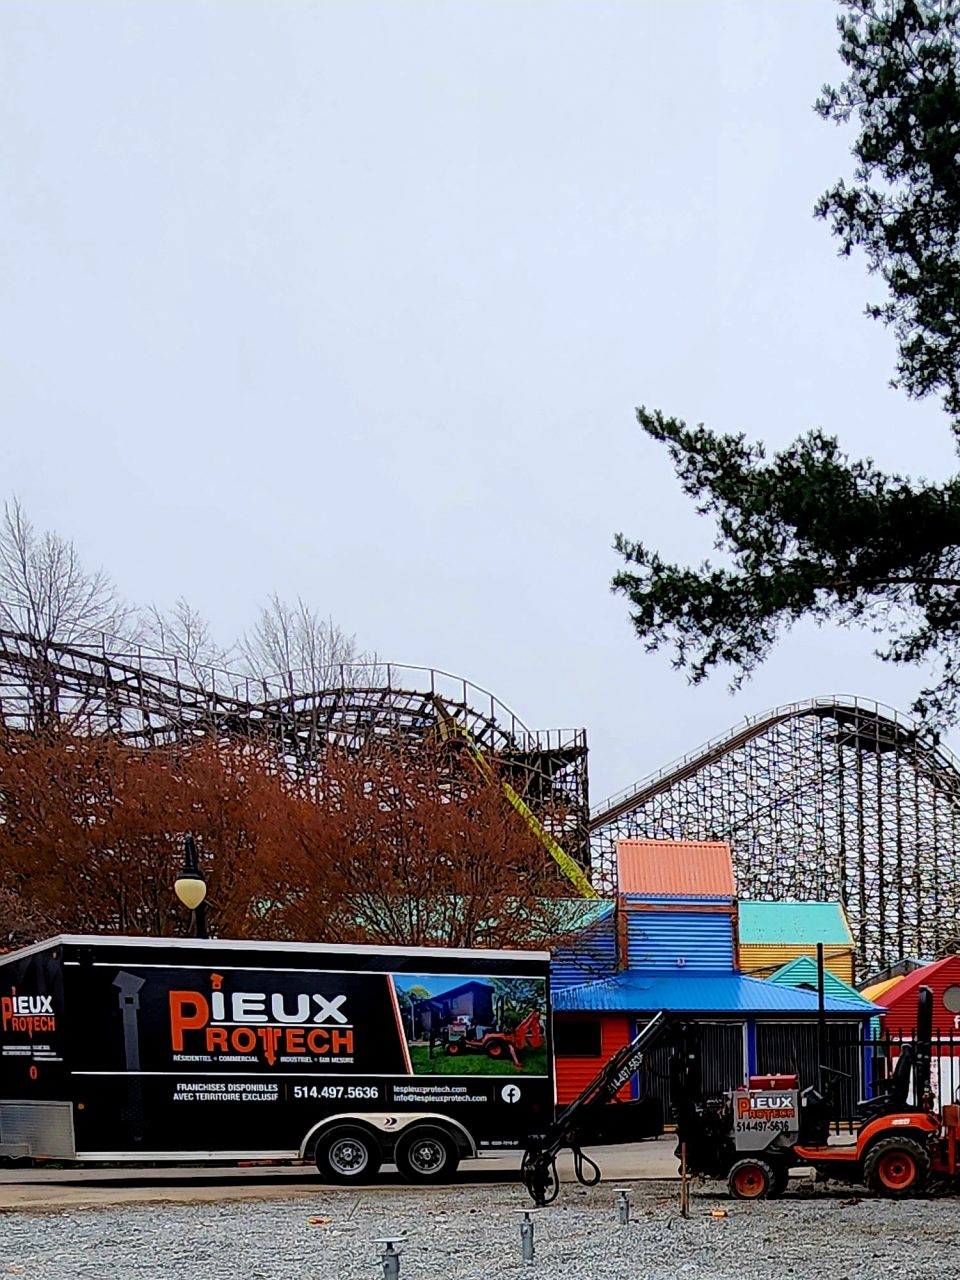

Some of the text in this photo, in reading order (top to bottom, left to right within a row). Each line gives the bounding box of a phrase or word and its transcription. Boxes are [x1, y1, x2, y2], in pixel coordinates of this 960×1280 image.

[177, 1083, 278, 1092] FRANCHISES DISPONIBLES
[294, 1086, 379, 1099] 514.497.5636
[242, 1093, 279, 1101] EXCLUSIF
[736, 1120, 789, 1132] 514-497-5636
